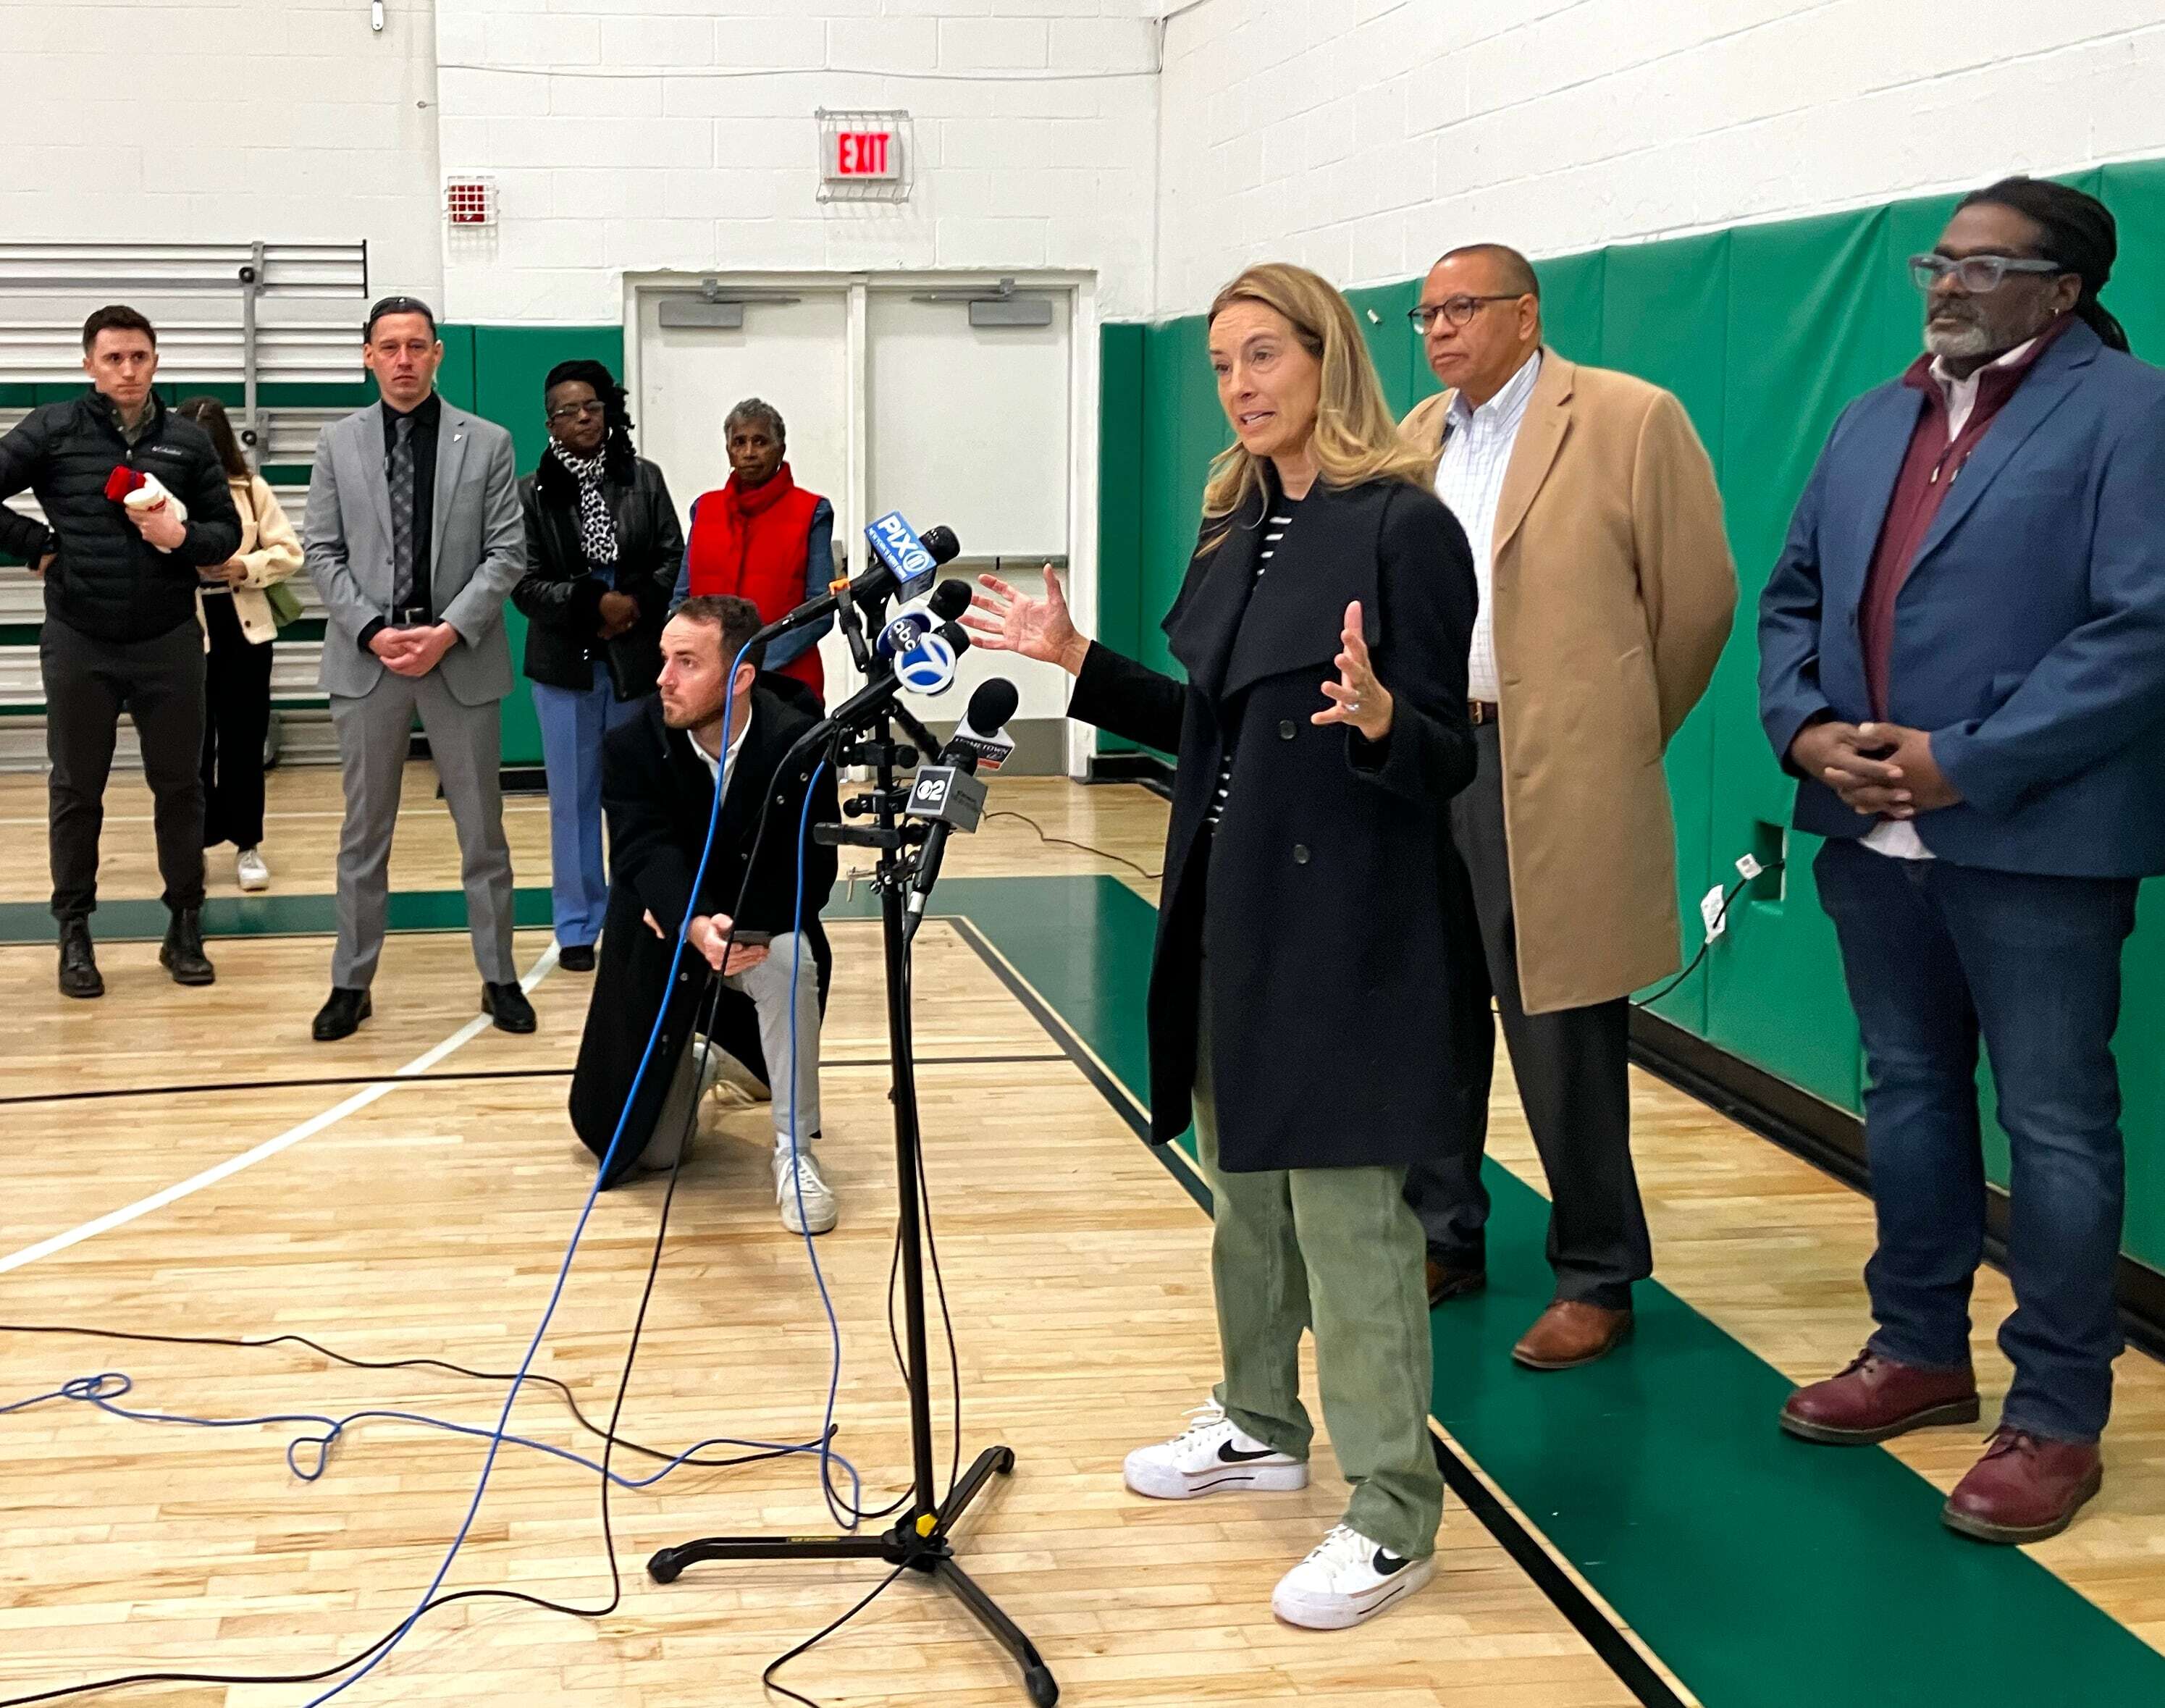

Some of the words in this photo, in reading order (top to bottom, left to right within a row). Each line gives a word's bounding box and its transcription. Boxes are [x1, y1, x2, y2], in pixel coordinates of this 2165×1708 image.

[839, 133, 889, 173] EXIT
[894, 620, 916, 651] abc
[899, 633, 951, 681] 7
